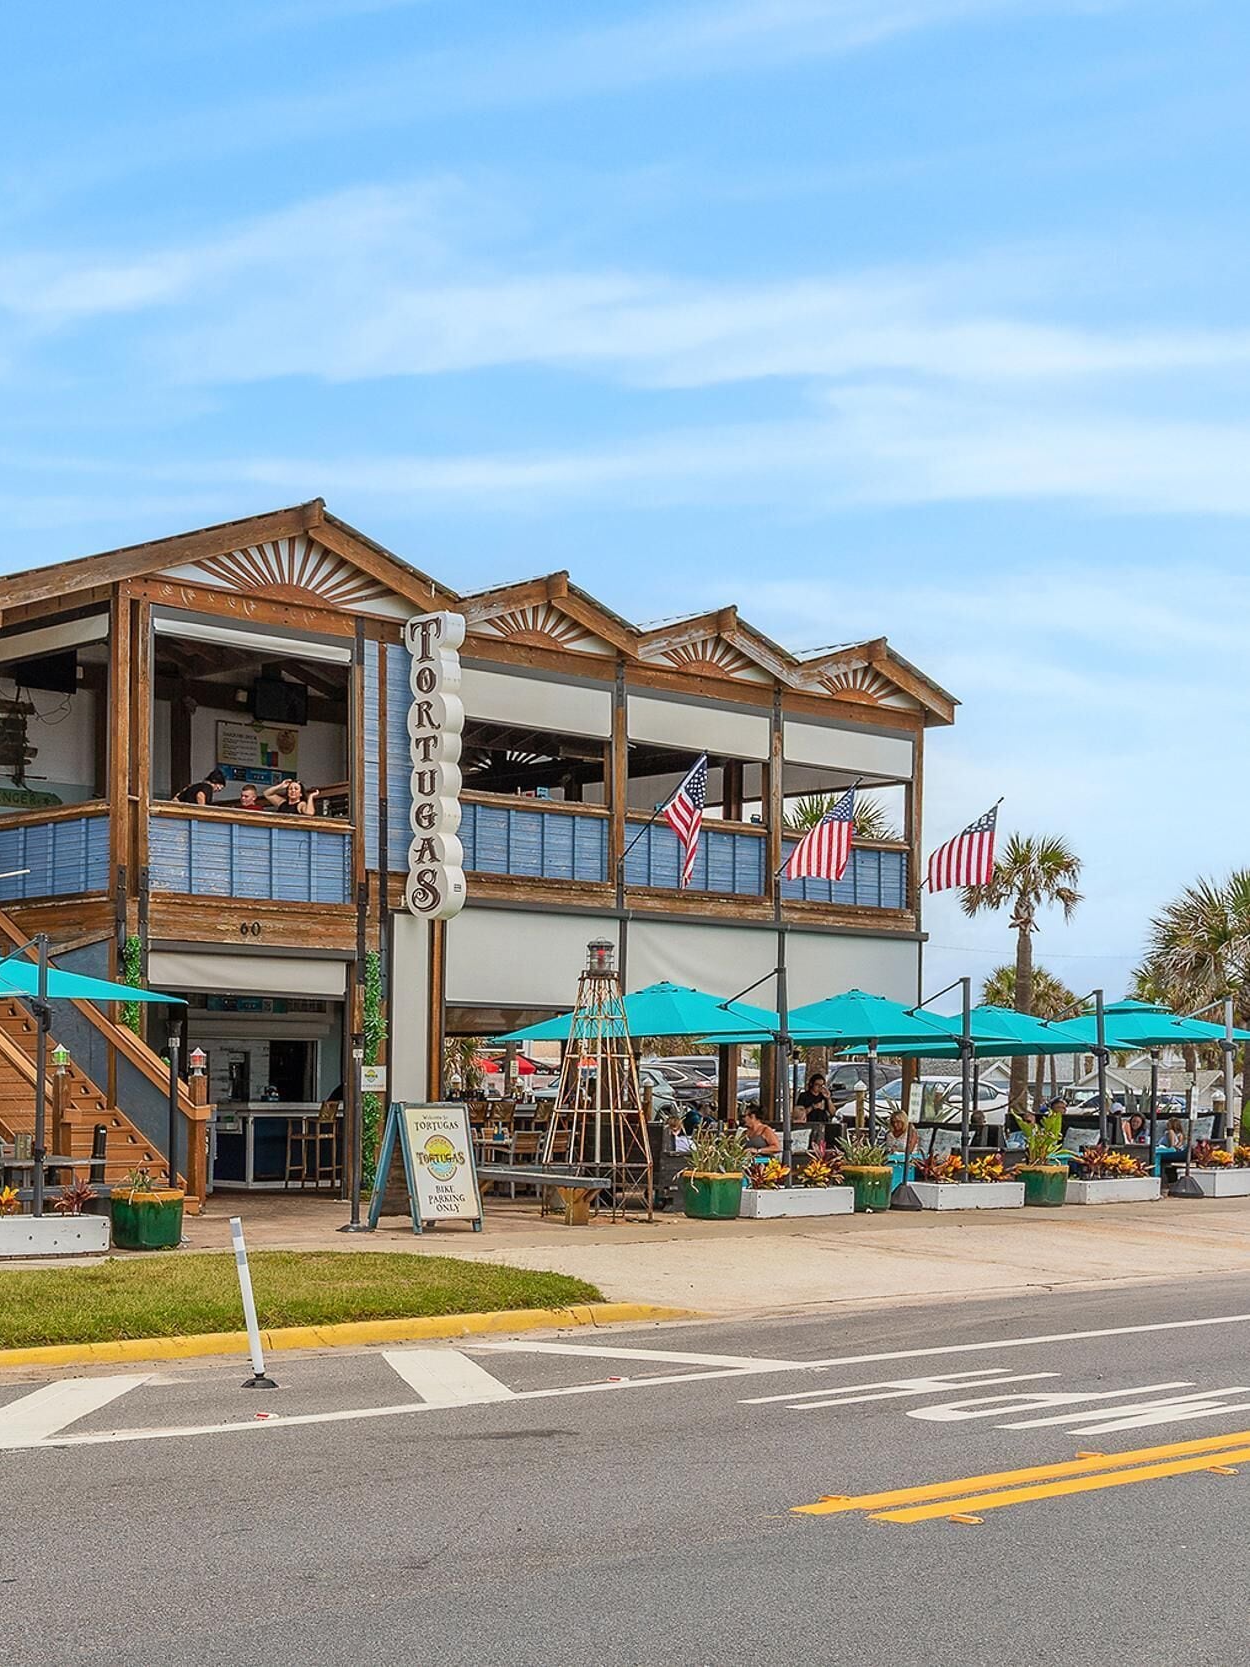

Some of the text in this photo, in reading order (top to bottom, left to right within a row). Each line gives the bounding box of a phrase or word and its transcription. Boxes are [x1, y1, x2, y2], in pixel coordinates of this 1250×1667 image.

[410, 616, 442, 912] TORTUGAS
[240, 922, 261, 936] 60
[414, 1120, 460, 1131] TORTUGAS
[416, 1152, 466, 1165] TORTUGAS
[435, 1185, 454, 1194] BIKE
[428, 1194, 466, 1205] PARKING
[436, 1203, 460, 1213] ONLY
